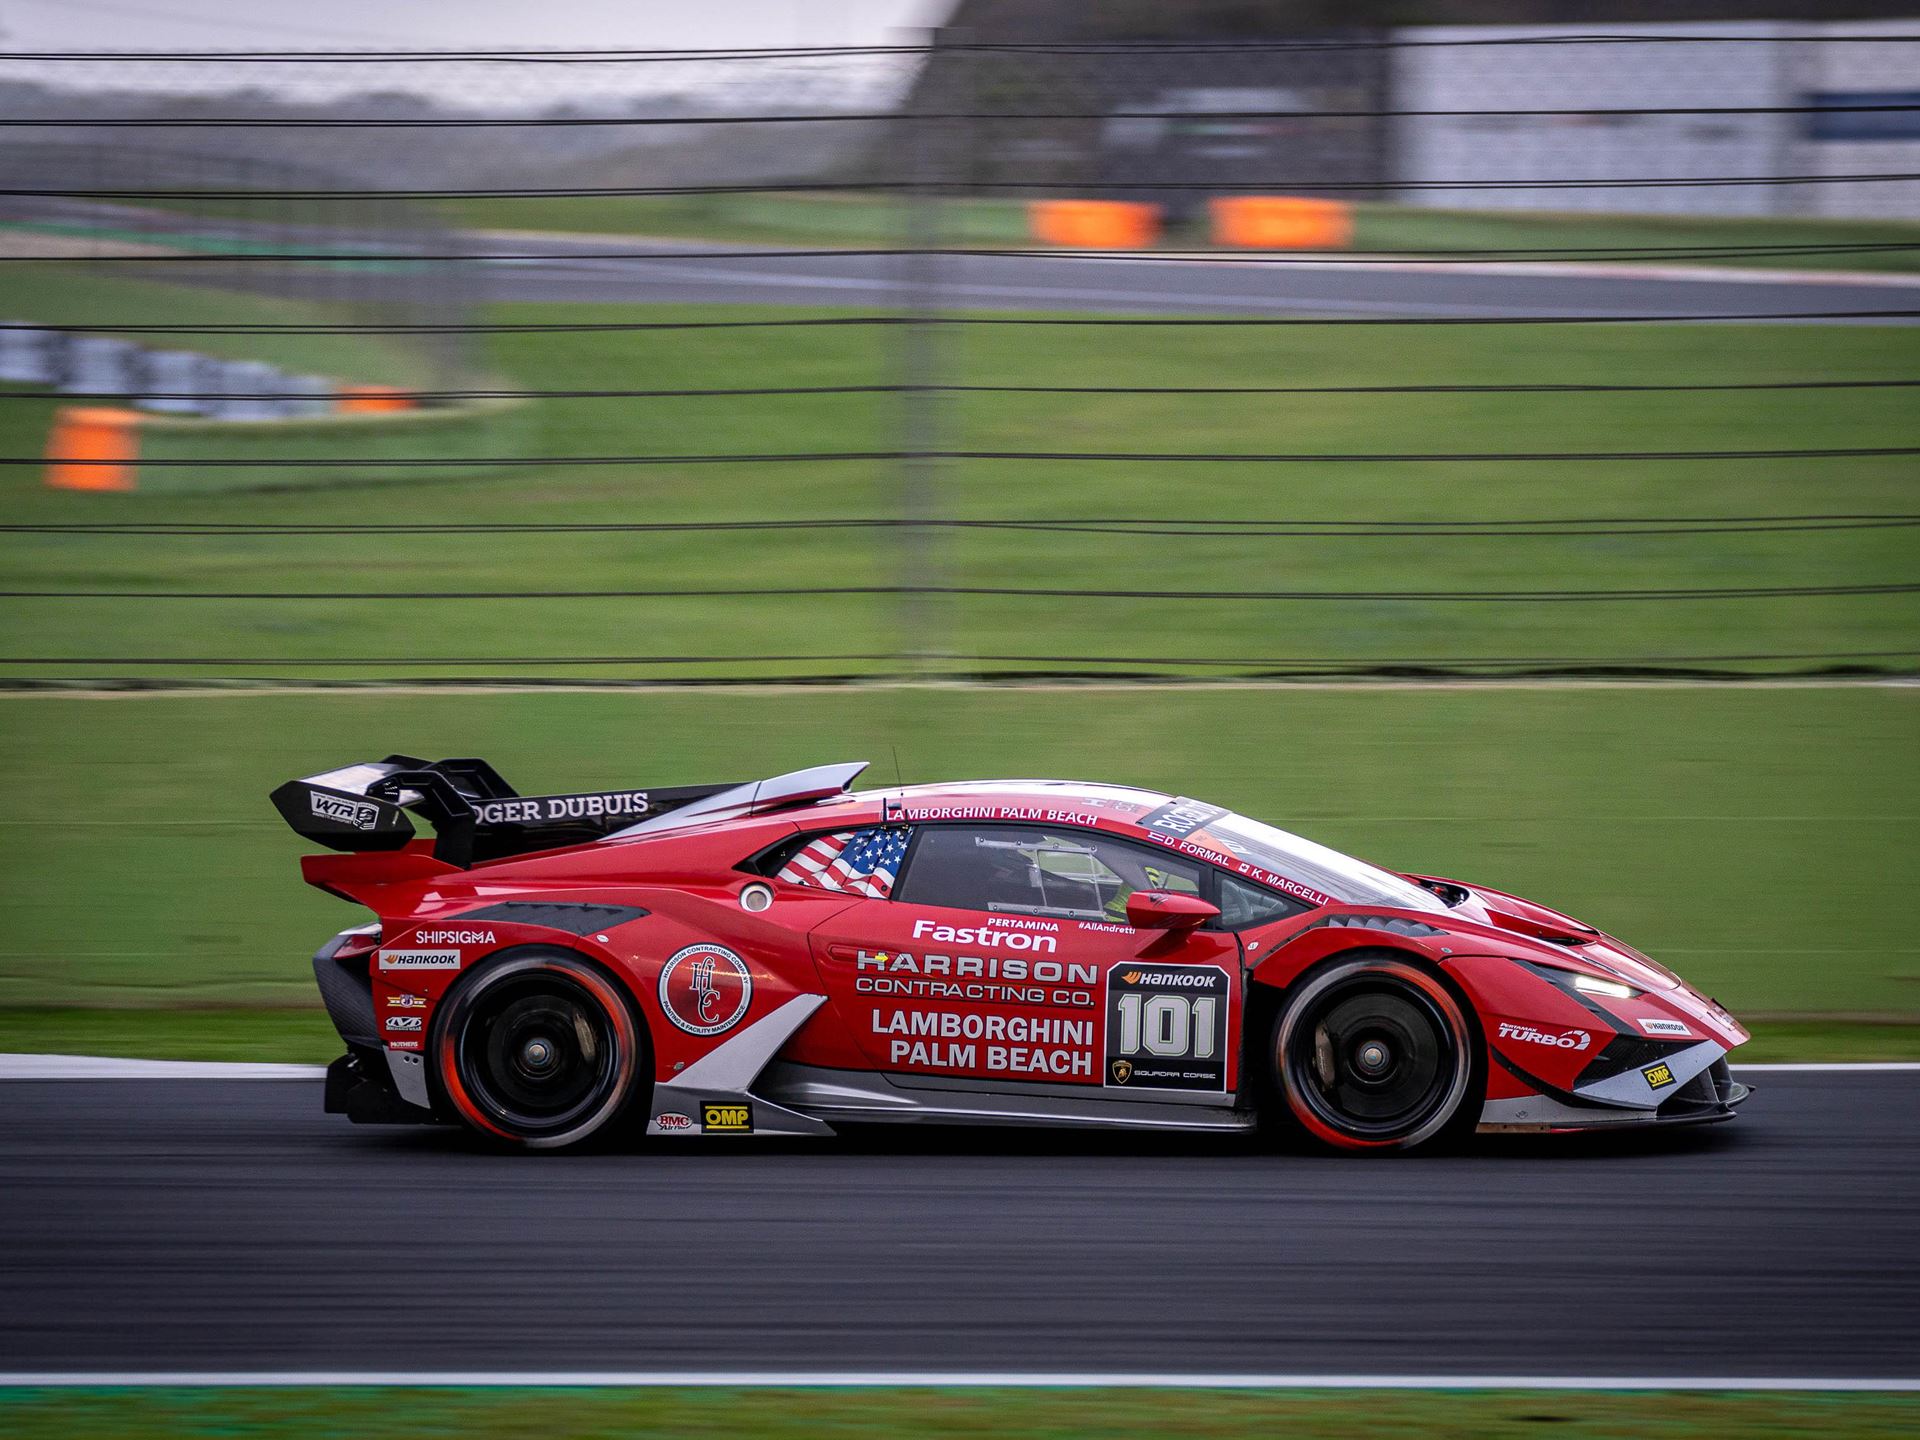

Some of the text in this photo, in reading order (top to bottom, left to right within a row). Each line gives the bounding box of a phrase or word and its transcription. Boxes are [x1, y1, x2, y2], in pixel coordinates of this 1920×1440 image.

[316, 798, 355, 817] WTR
[473, 793, 648, 824] OGER DUBUIS
[887, 807, 1098, 826] LAMBORGHINI PALM BEACH
[1164, 836, 1175, 847] D.
[1179, 841, 1230, 866] FORMAL
[1251, 868, 1330, 906] K. MARCELLI
[416, 931, 496, 944] SHIPSIGMA
[912, 919, 1057, 953] Fastron
[987, 917, 1059, 932] PERTAMINA
[664, 952, 686, 978] HARRISON
[687, 946, 731, 958] CONTRACTING
[857, 951, 1098, 985] HARRISON
[855, 978, 1095, 1006] CONTRACTING CO.
[663, 1000, 681, 1025] PAINTING
[686, 1025, 711, 1033] FACILITY
[712, 1005, 745, 1032] MAINTENANCE
[872, 1009, 1093, 1046] LAMBORGHINI
[1118, 994, 1216, 1058] 101
[1500, 1022, 1537, 1032] PERTAMAX
[1499, 1027, 1575, 1048] TURBO
[891, 1040, 1092, 1076] PALM BEACH
[1647, 1068, 1669, 1084] OMP
[660, 1116, 689, 1126] BMC
[706, 1109, 748, 1125] OMP
